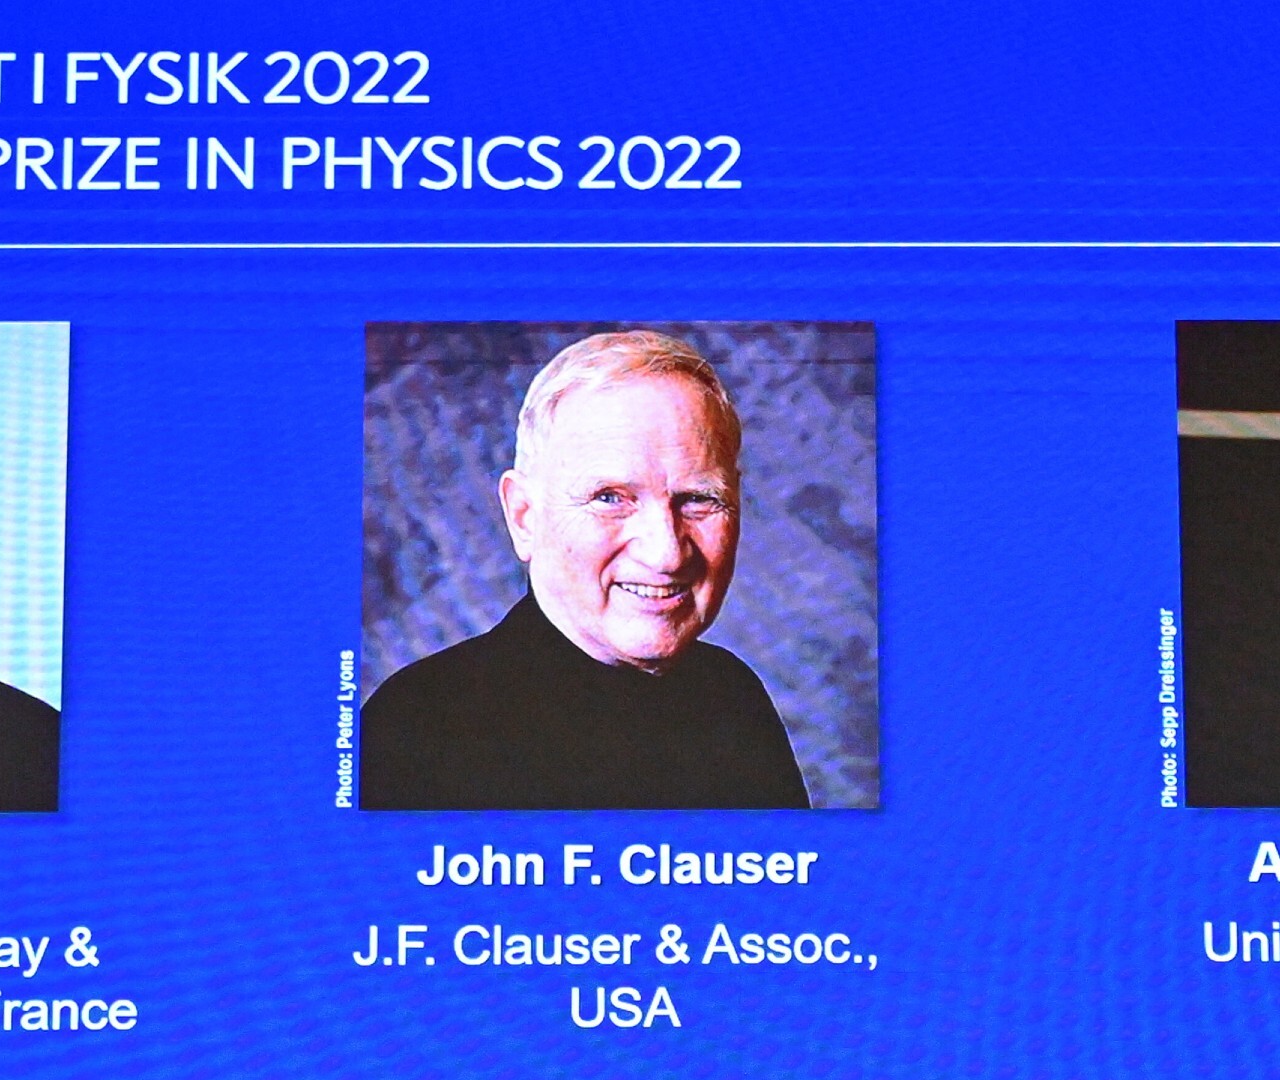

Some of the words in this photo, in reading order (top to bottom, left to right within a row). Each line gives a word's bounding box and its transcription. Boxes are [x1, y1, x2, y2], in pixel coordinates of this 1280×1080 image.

[33, 52, 44, 104] I
[66, 51, 250, 105] FYSIK
[263, 51, 430, 105] 2022
[187, 137, 254, 190] IN
[283, 135, 563, 190] PHYSICS
[578, 135, 742, 190] 2022
[337, 649, 357, 702] Lyons
[1158, 608, 1177, 704] Dreissinger
[336, 705, 354, 749] Peter
[1160, 705, 1179, 749] Sepp
[335, 753, 353, 808] Photo:
[1161, 753, 1178, 808] Photo:
[416, 845, 544, 886] John
[563, 844, 601, 885] F.
[619, 844, 819, 885] Clauser
[64, 926, 100, 967] &
[353, 924, 435, 966] J.F.
[453, 924, 642, 966] Clauser
[655, 923, 691, 965] &
[701, 923, 877, 971] Assoc.,
[571, 986, 682, 1028] USA
